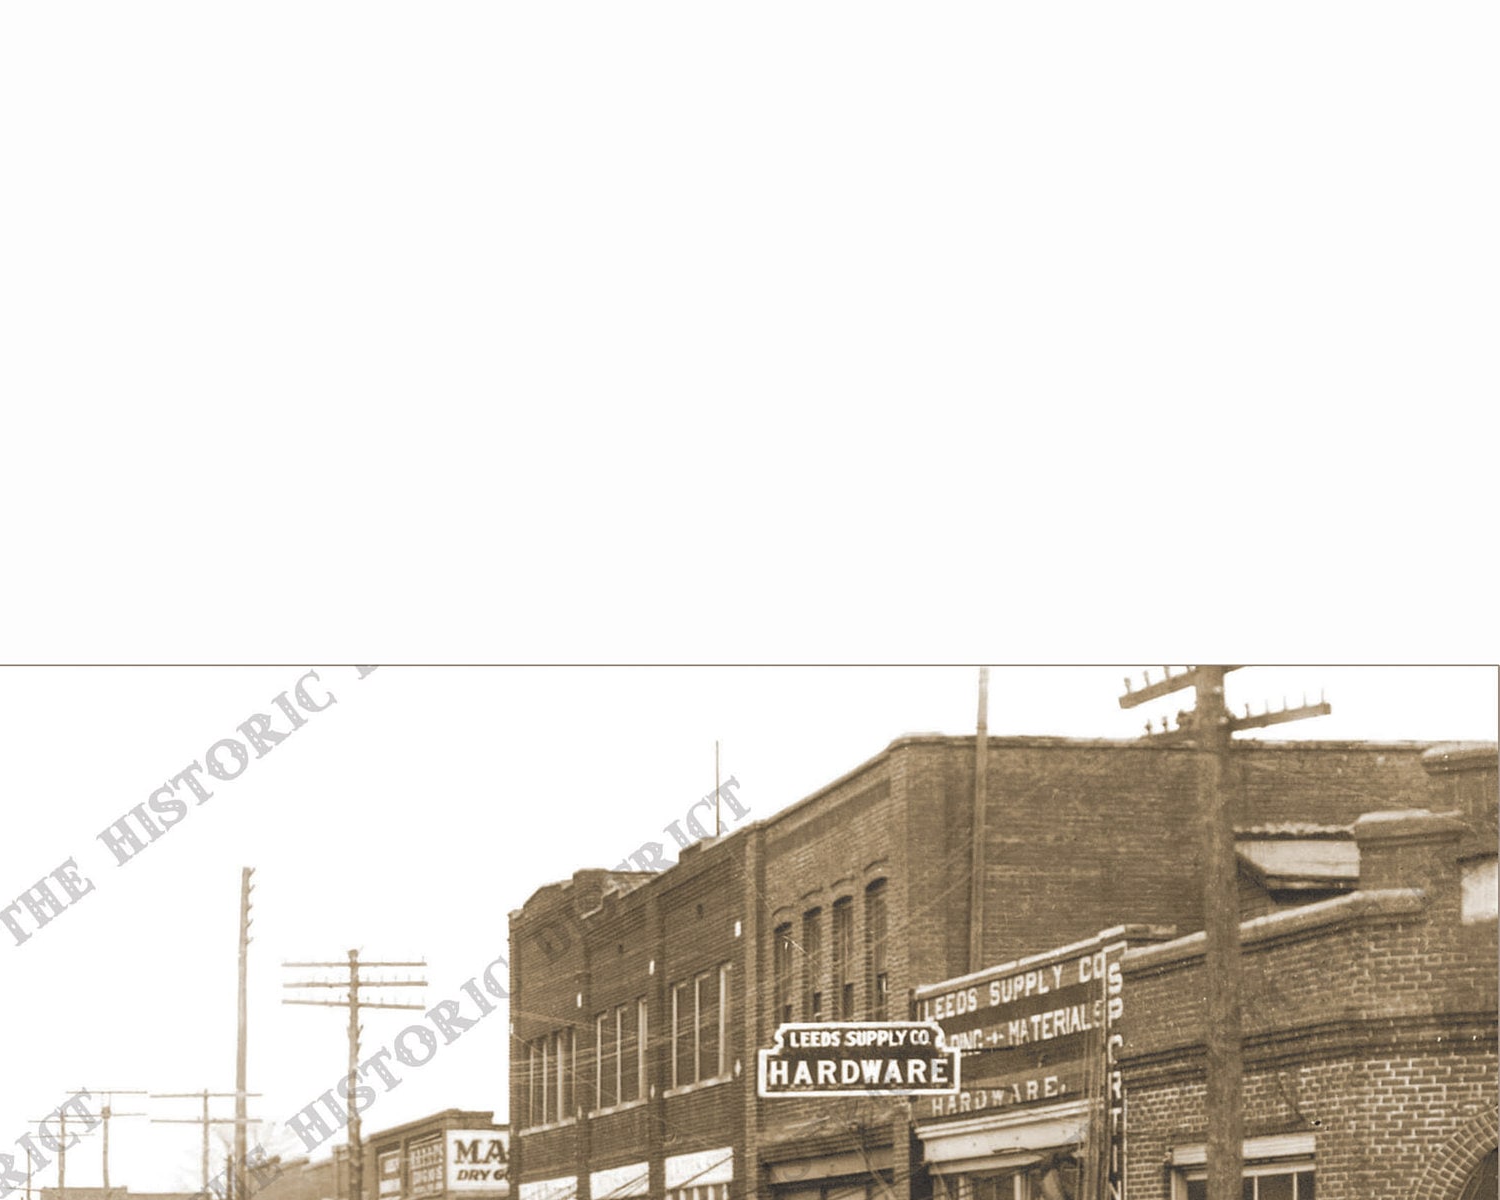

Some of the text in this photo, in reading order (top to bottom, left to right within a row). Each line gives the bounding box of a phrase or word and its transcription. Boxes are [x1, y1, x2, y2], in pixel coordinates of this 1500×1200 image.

[924, 987, 978, 1023] LEEDS
[989, 964, 1063, 1006] SUPPLY
[789, 1030, 841, 1048] LEEDS
[845, 1029, 907, 1047] SUPPLY
[769, 1058, 949, 1086] HARDWARE
[457, 1169, 491, 1182] DRY
